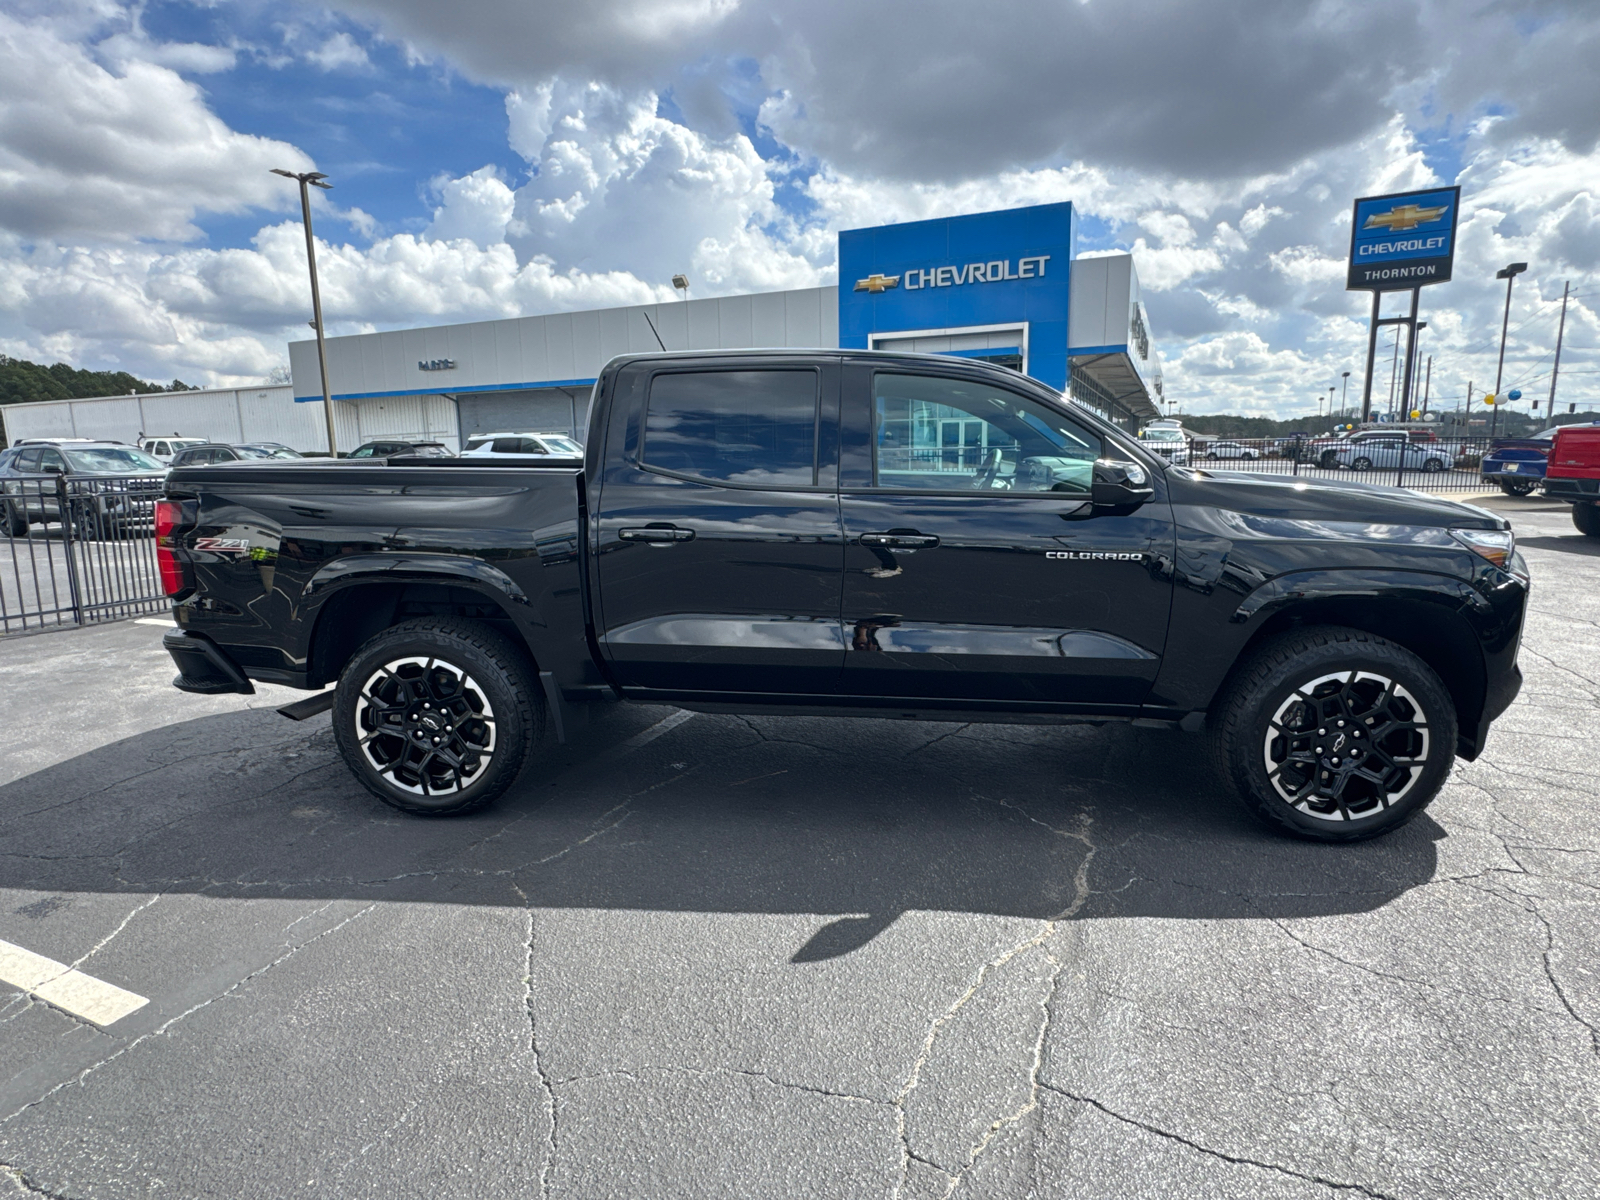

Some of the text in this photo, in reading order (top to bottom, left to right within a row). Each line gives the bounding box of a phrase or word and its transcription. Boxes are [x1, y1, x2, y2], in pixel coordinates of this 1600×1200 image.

[1359, 237, 1445, 256] CHEVROLET
[904, 255, 1050, 290] CHEVROLET
[1364, 265, 1436, 280] THORNTON
[193, 537, 250, 552] Z71
[1045, 551, 1143, 561] COLORADO
